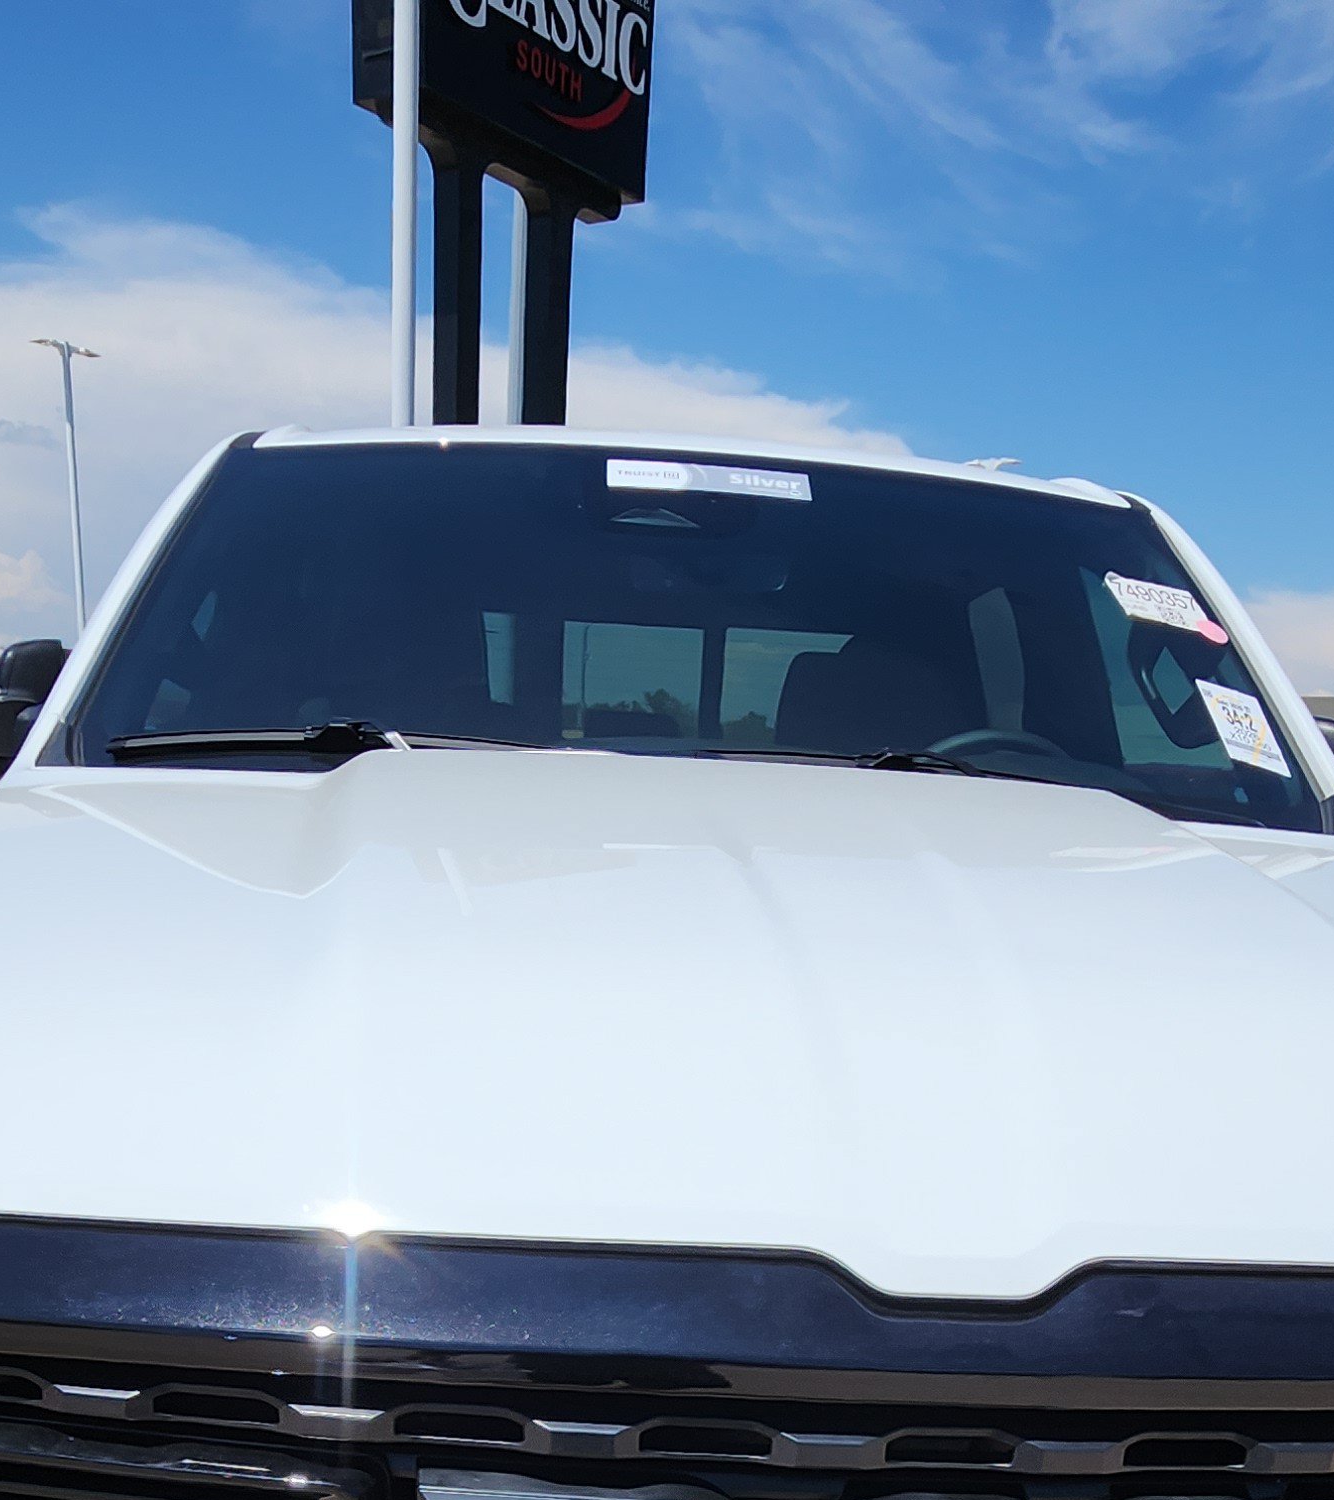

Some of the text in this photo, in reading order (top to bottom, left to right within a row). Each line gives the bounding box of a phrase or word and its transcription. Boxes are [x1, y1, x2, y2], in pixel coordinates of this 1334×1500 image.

[450, 0, 647, 95] SSIC
[517, 39, 583, 102] SOUTH
[730, 472, 802, 490] Silver
[1109, 580, 1196, 611] 7490357
